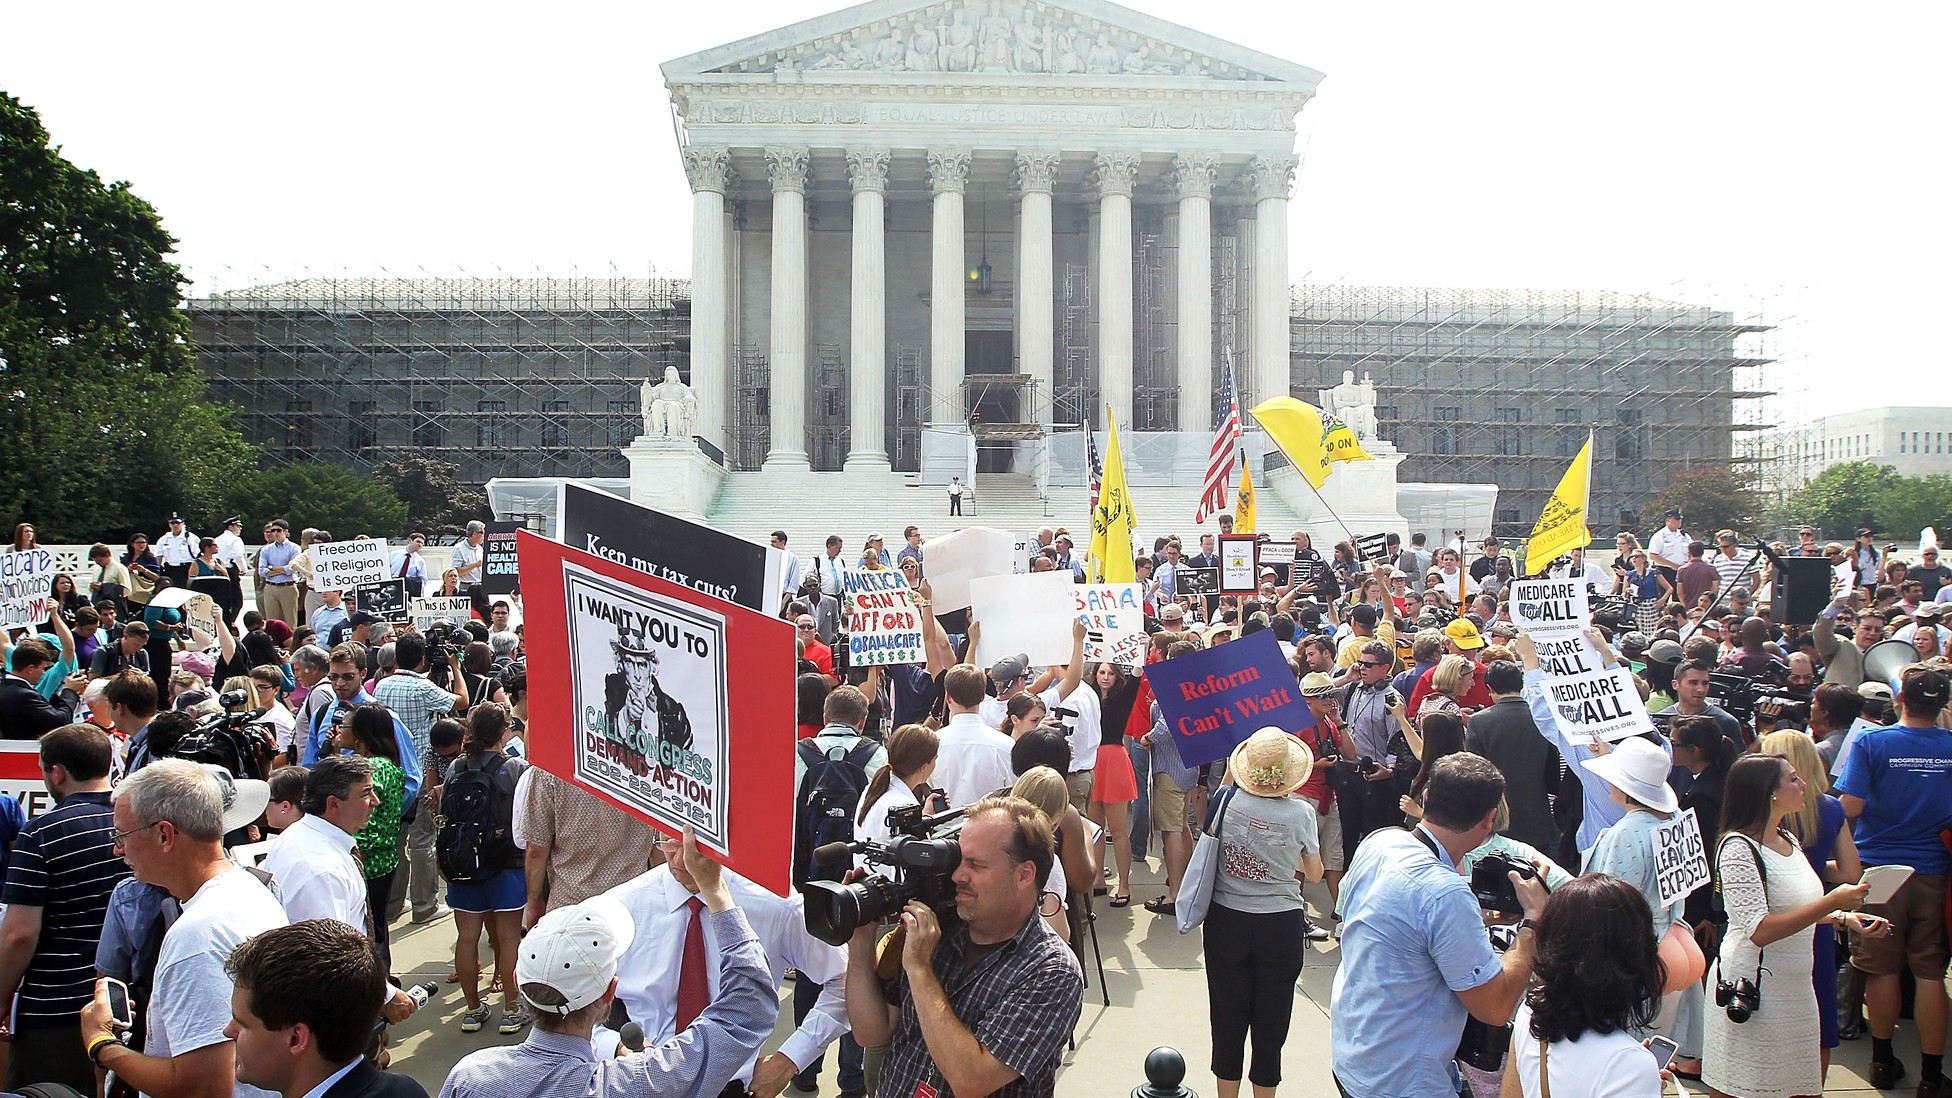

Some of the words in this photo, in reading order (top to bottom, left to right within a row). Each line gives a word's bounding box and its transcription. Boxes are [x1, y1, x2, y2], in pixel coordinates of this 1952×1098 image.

[879, 108, 937, 122] EQUAL
[940, 108, 1006, 122] JUSTICE
[1014, 109, 1071, 123] UNDER
[1076, 110, 1109, 123] LAW
[1337, 438, 1352, 449] ON
[488, 533, 517, 541] ABORTI
[318, 542, 378, 556] Freedom
[489, 543, 498, 552] IS
[315, 561, 329, 573] of
[332, 558, 384, 572] Religion
[487, 554, 518, 562] HEALT
[487, 563, 519, 575] CARE
[322, 576, 332, 587] Is
[334, 572, 382, 586] Sacred
[661, 565, 691, 587] tax
[694, 578, 738, 601] cuts?
[843, 570, 908, 594] AMERICA
[857, 590, 908, 609] CAN'T
[1517, 587, 1576, 601] MEDICARE
[415, 599, 437, 610] This
[439, 599, 447, 611] is
[449, 599, 471, 610] NOT
[1543, 600, 1578, 621] ALL
[578, 593, 583, 612] I
[586, 596, 633, 629] WANT
[635, 612, 679, 648] YOU
[683, 632, 709, 658] TO
[850, 611, 915, 632] AFFORD
[1524, 624, 1580, 633] OLDPROGRESSIVES.ORG
[850, 632, 922, 654] OBAMACARE
[1110, 634, 1139, 654] LESS
[1534, 637, 1584, 657] EDICARE
[1112, 647, 1140, 664] CARE
[1552, 655, 1592, 676] ALL
[1177, 666, 1261, 701] Reform
[1550, 675, 1624, 702] MEDICARE
[1178, 707, 1235, 737] Can't
[1234, 687, 1292, 718] Wait
[1583, 695, 1632, 725] ALL
[585, 705, 624, 743] CALL
[625, 724, 713, 785] CONGRESS
[586, 731, 649, 778] DEMAND
[652, 764, 712, 810] ACTION
[587, 755, 713, 829] 202-224-3121
[1660, 813, 1694, 848] DON'T
[1686, 833, 1702, 858] US
